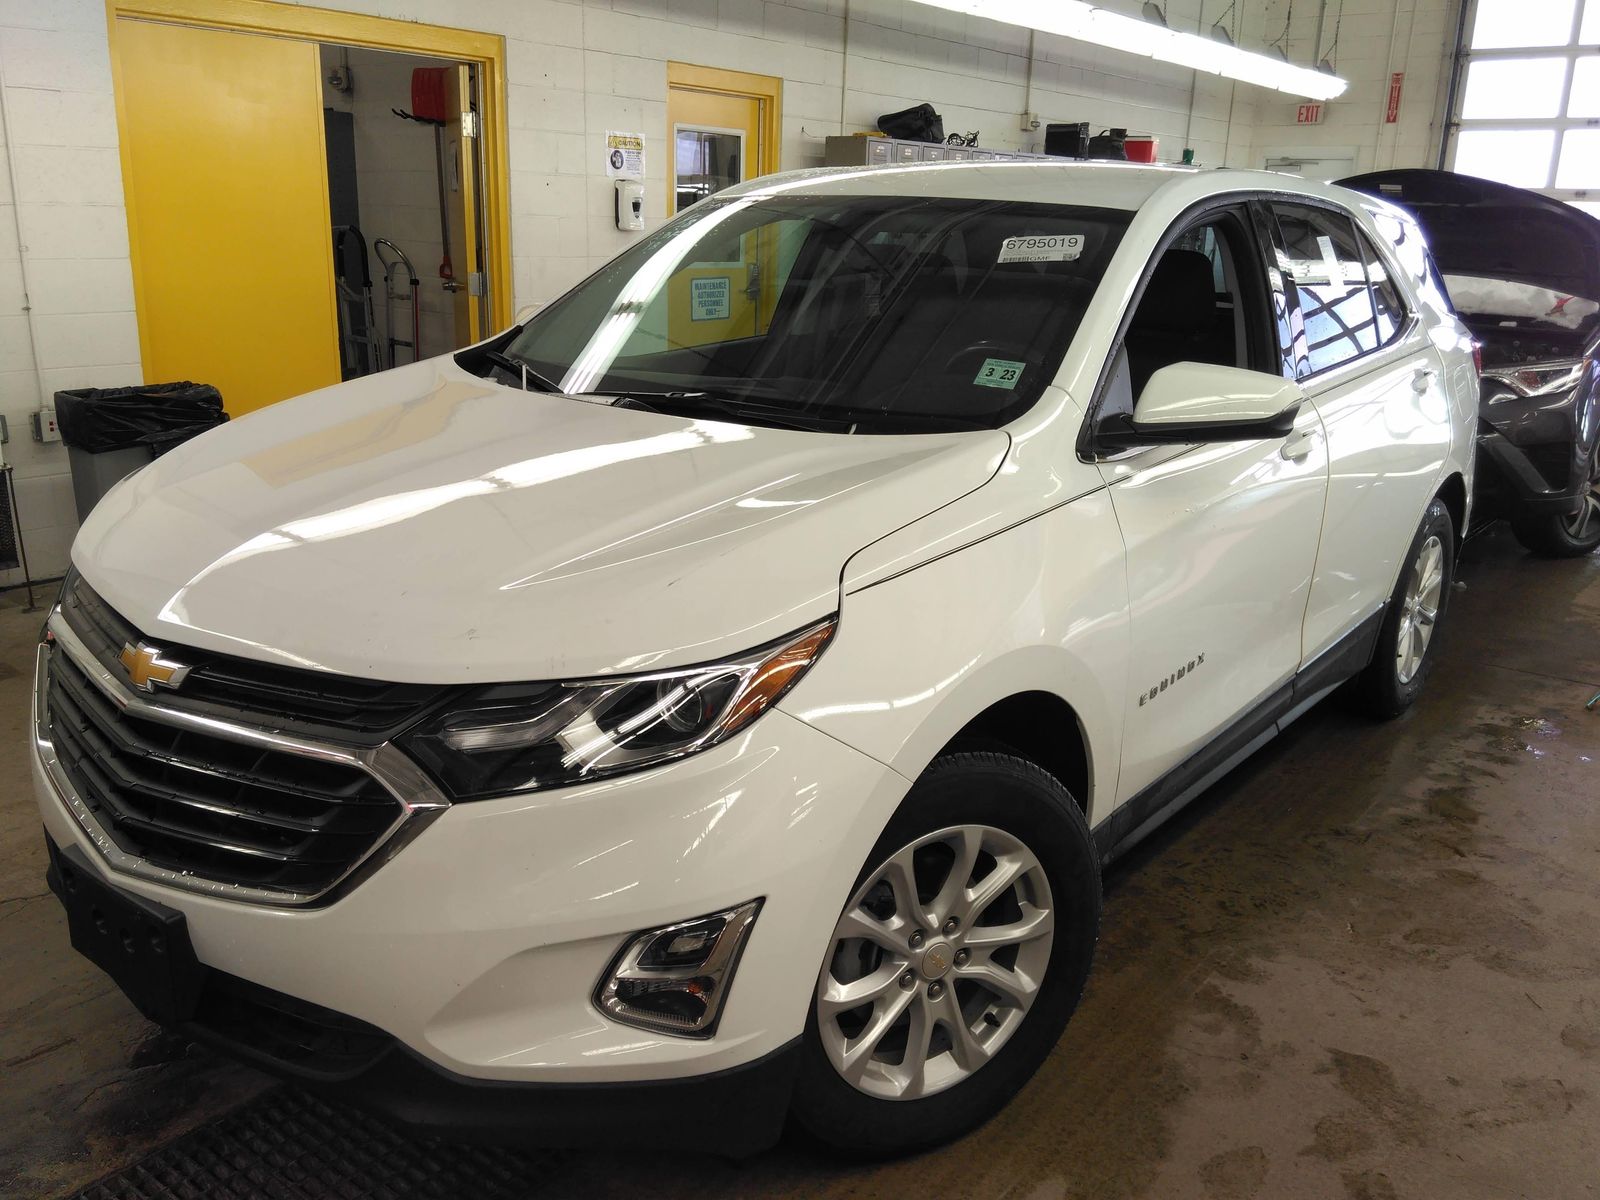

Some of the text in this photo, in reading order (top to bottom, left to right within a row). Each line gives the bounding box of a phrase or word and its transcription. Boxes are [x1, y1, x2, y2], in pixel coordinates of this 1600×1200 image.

[1297, 105, 1321, 123] EXIT
[618, 139, 641, 148] CAUTION
[1006, 237, 1079, 250] 6795019
[694, 281, 728, 290] MAINTENANCE
[698, 299, 724, 308] PERSONNEL
[985, 367, 1017, 381] 3 23
[1138, 651, 1206, 708] EQUINOX
